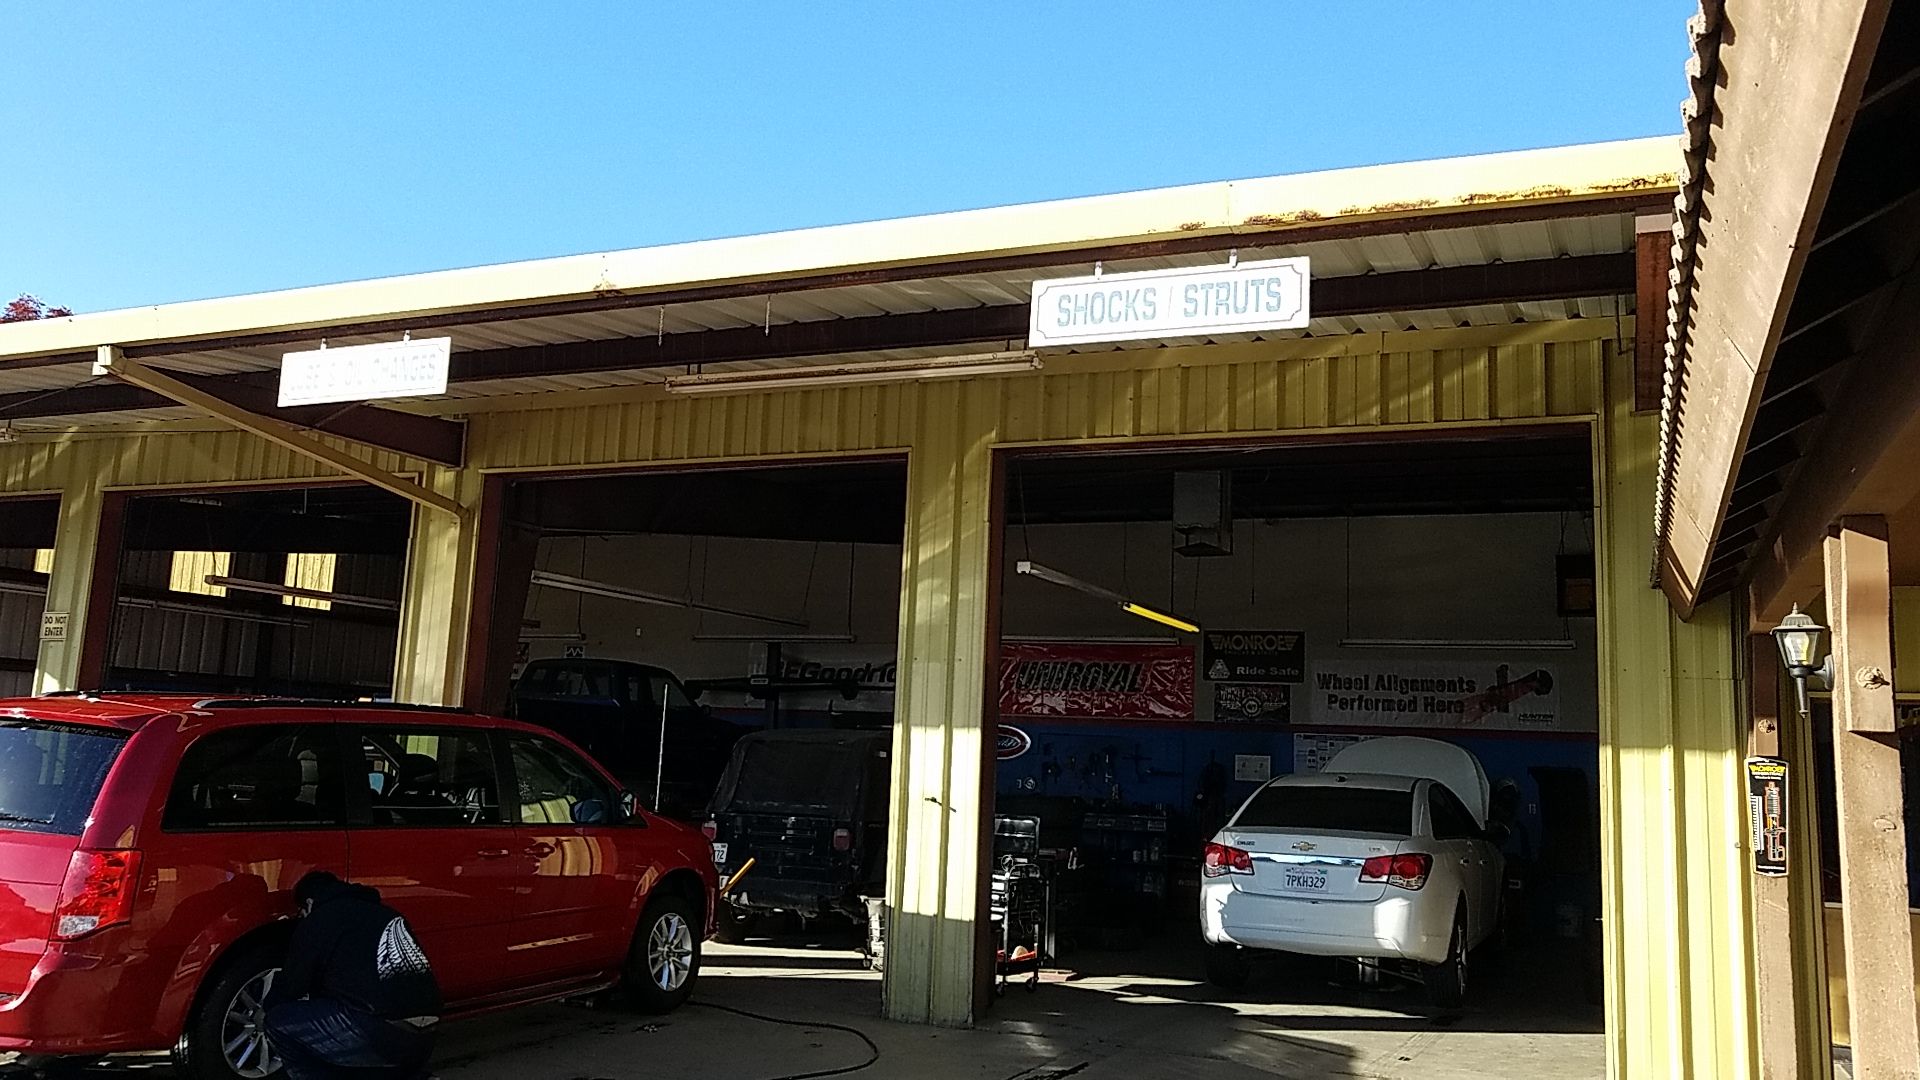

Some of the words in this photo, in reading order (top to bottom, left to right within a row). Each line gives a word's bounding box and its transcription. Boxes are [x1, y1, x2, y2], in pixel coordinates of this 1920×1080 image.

[1057, 287, 1157, 327] SHOCKS
[1183, 277, 1282, 318] STRUTS
[44, 616, 53, 624] DO
[55, 616, 67, 624] NOT
[44, 627, 63, 636] ENTER
[1219, 634, 1288, 651] MONROE
[1015, 661, 1144, 692] UNIROYAL
[1236, 666, 1266, 676] Ride
[1269, 666, 1300, 676] Safe
[1316, 673, 1370, 691] Wheel
[1374, 673, 1476, 694] Alignments
[1327, 694, 1418, 713] Performed
[1423, 696, 1465, 714] Here
[1286, 874, 1326, 889] 7PKH329
